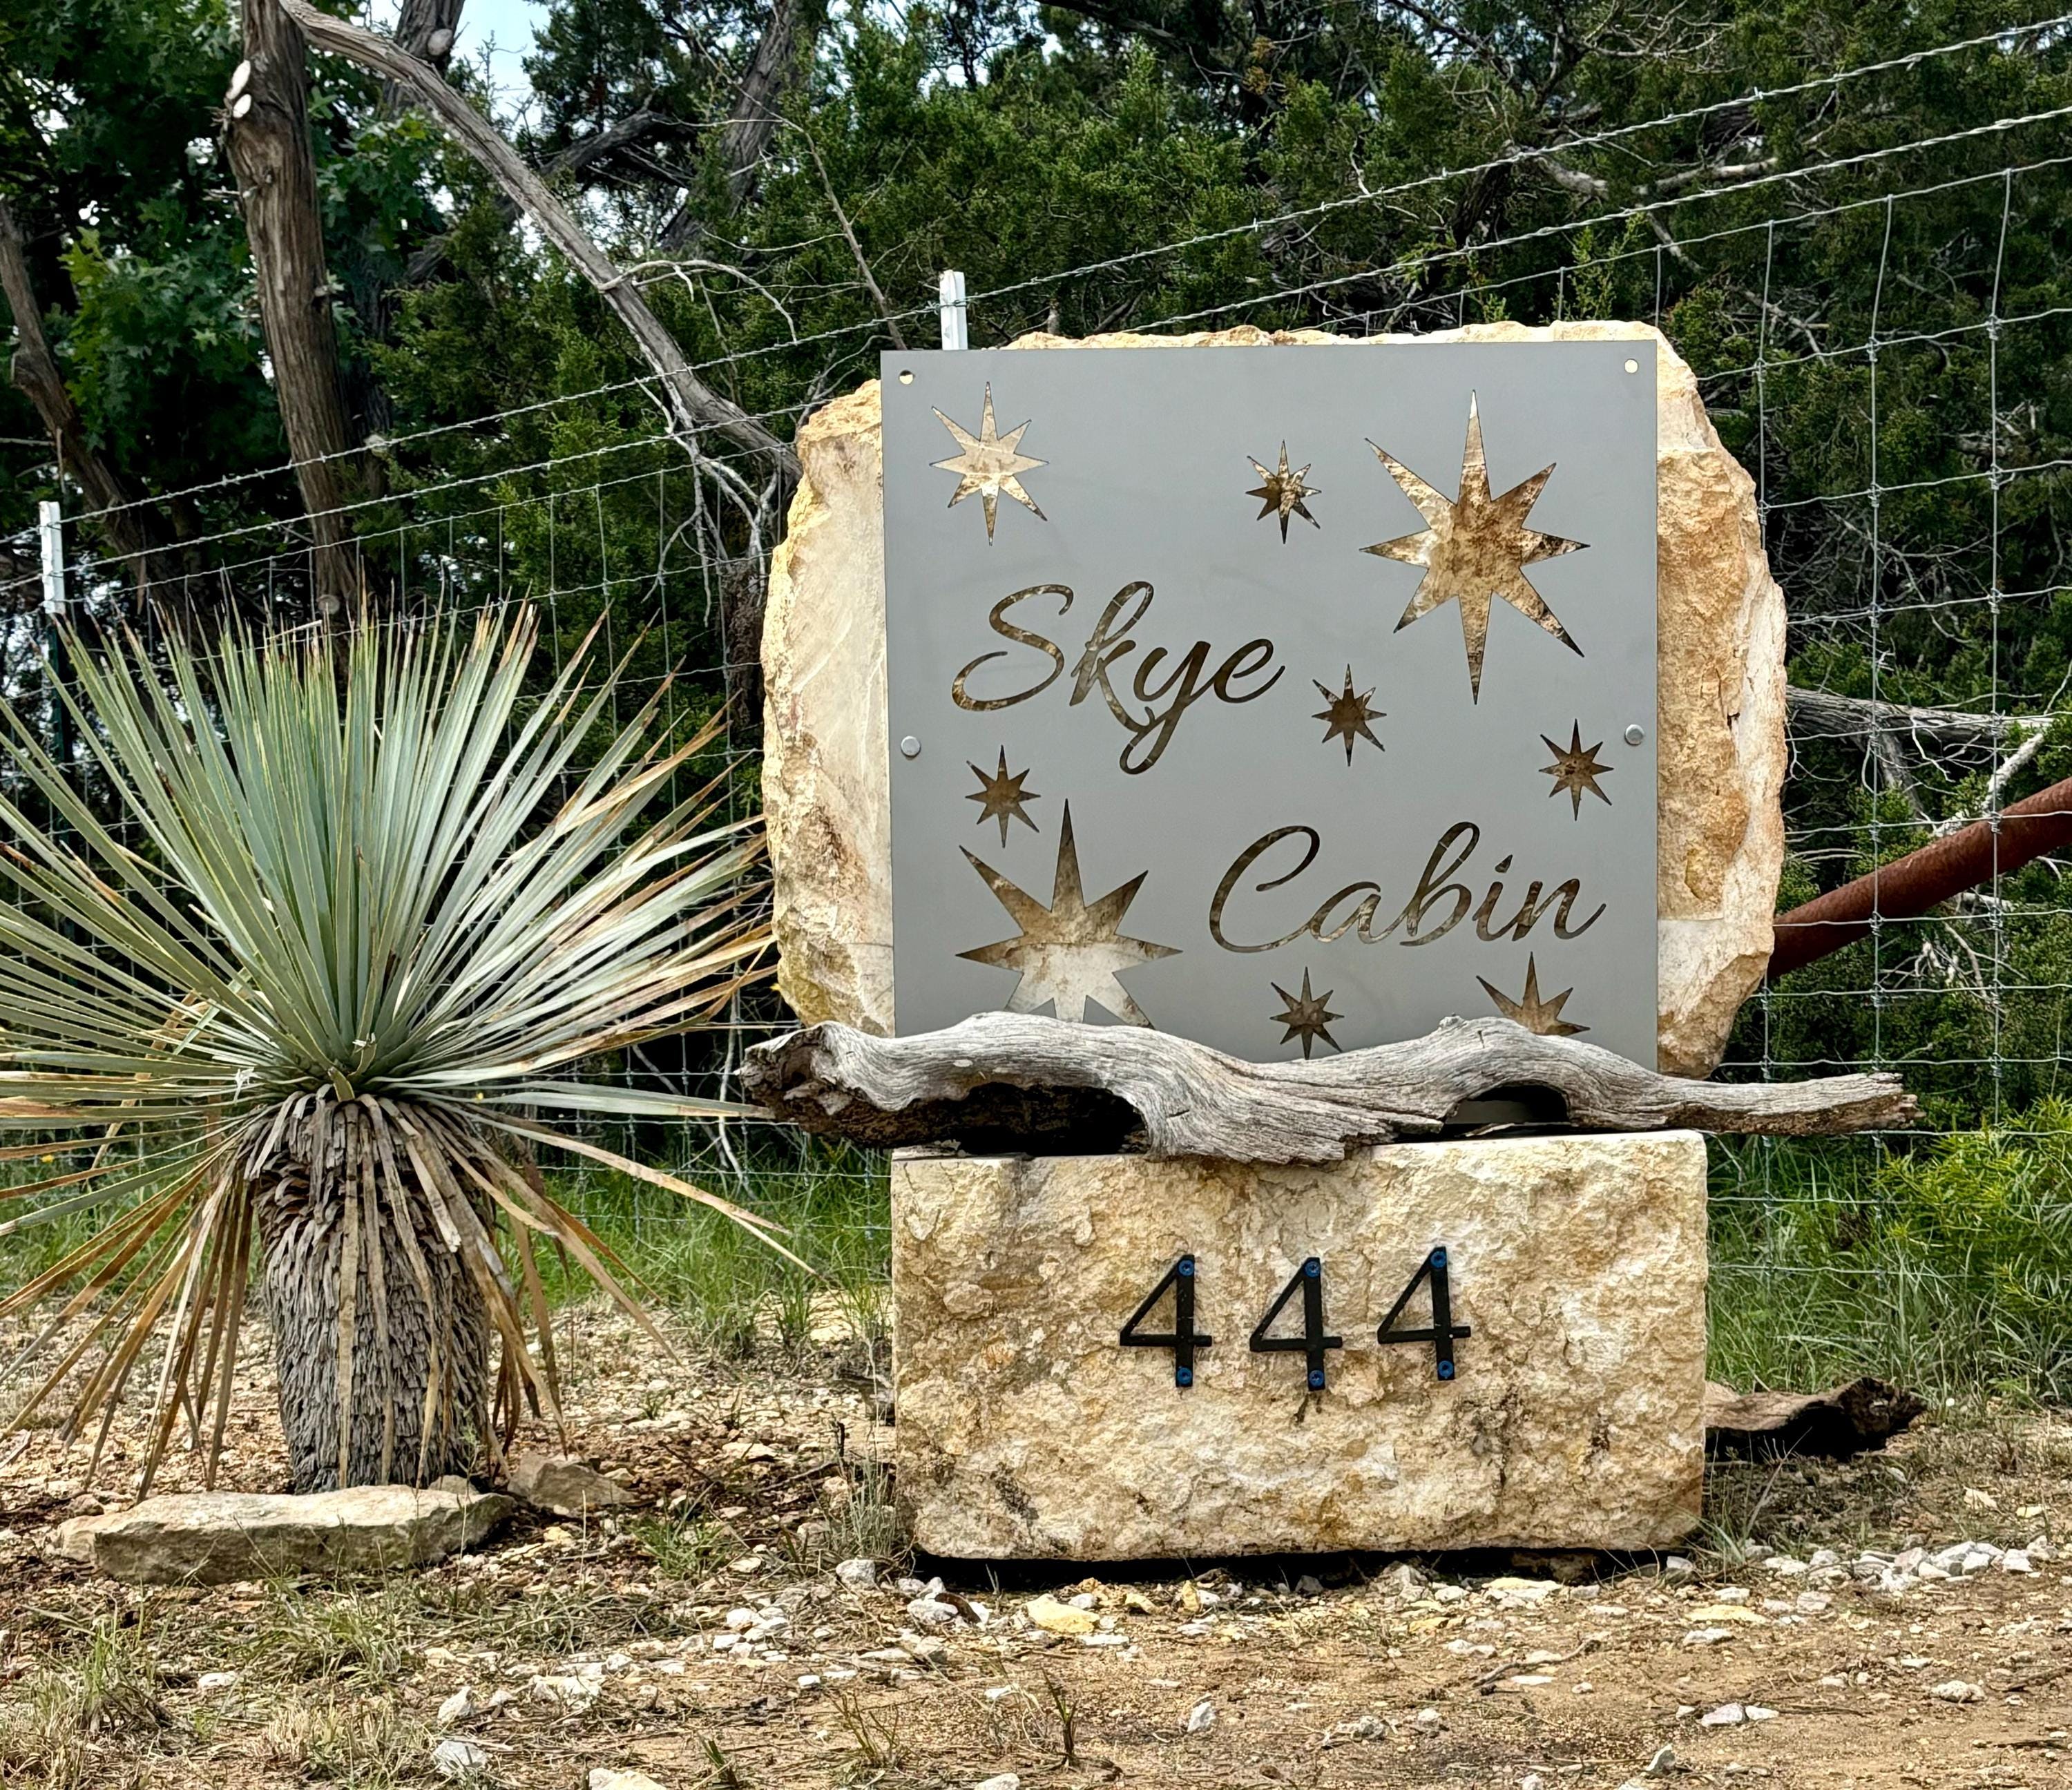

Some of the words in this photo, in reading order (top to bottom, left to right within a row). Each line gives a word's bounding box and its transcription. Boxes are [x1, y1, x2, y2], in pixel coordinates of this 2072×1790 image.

[952, 581, 1285, 774] Skye
[1209, 821, 1606, 953] Cabin
[1120, 1247, 1471, 1390] 444
